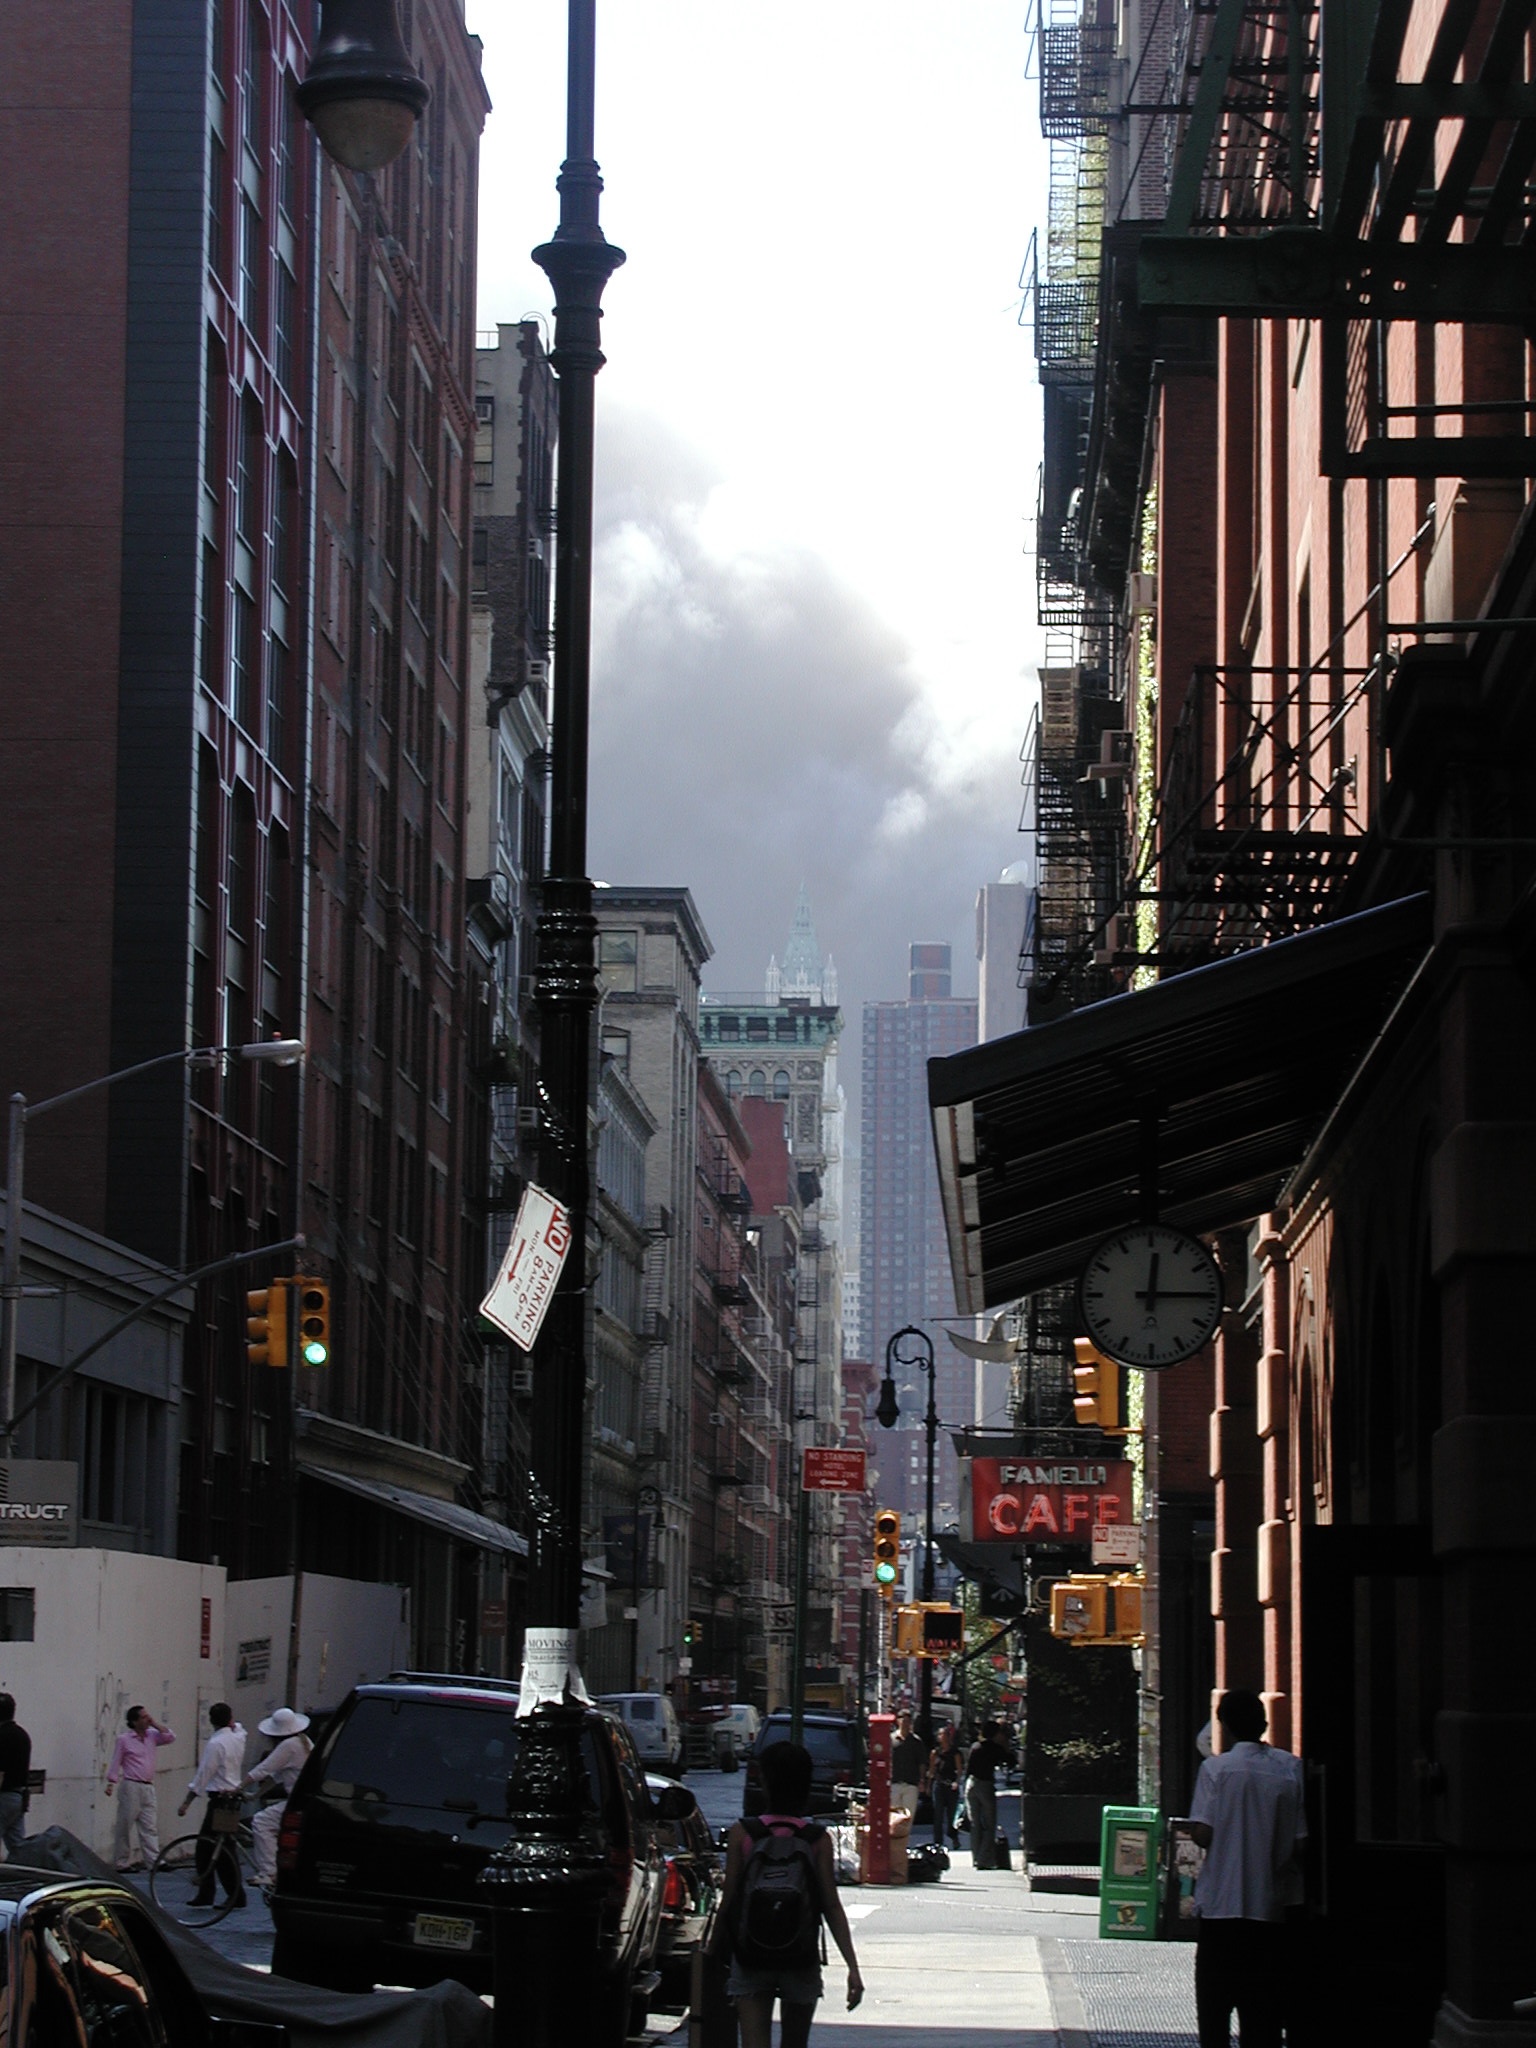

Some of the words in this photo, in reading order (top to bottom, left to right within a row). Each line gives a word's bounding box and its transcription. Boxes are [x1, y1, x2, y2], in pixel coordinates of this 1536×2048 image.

[548, 1209, 569, 1254] NO
[521, 1260, 555, 1333] PARKING
[808, 1451, 819, 1461] NO
[823, 1452, 862, 1463] STANDING
[1000, 1465, 1107, 1485] FANELLI
[988, 1493, 1120, 1535] CAFE
[1095, 1528, 1108, 1542] NO
[1111, 1530, 1138, 1538] PARKING
[528, 1639, 573, 1649] MOVING
[927, 1638, 958, 1649] WALK
